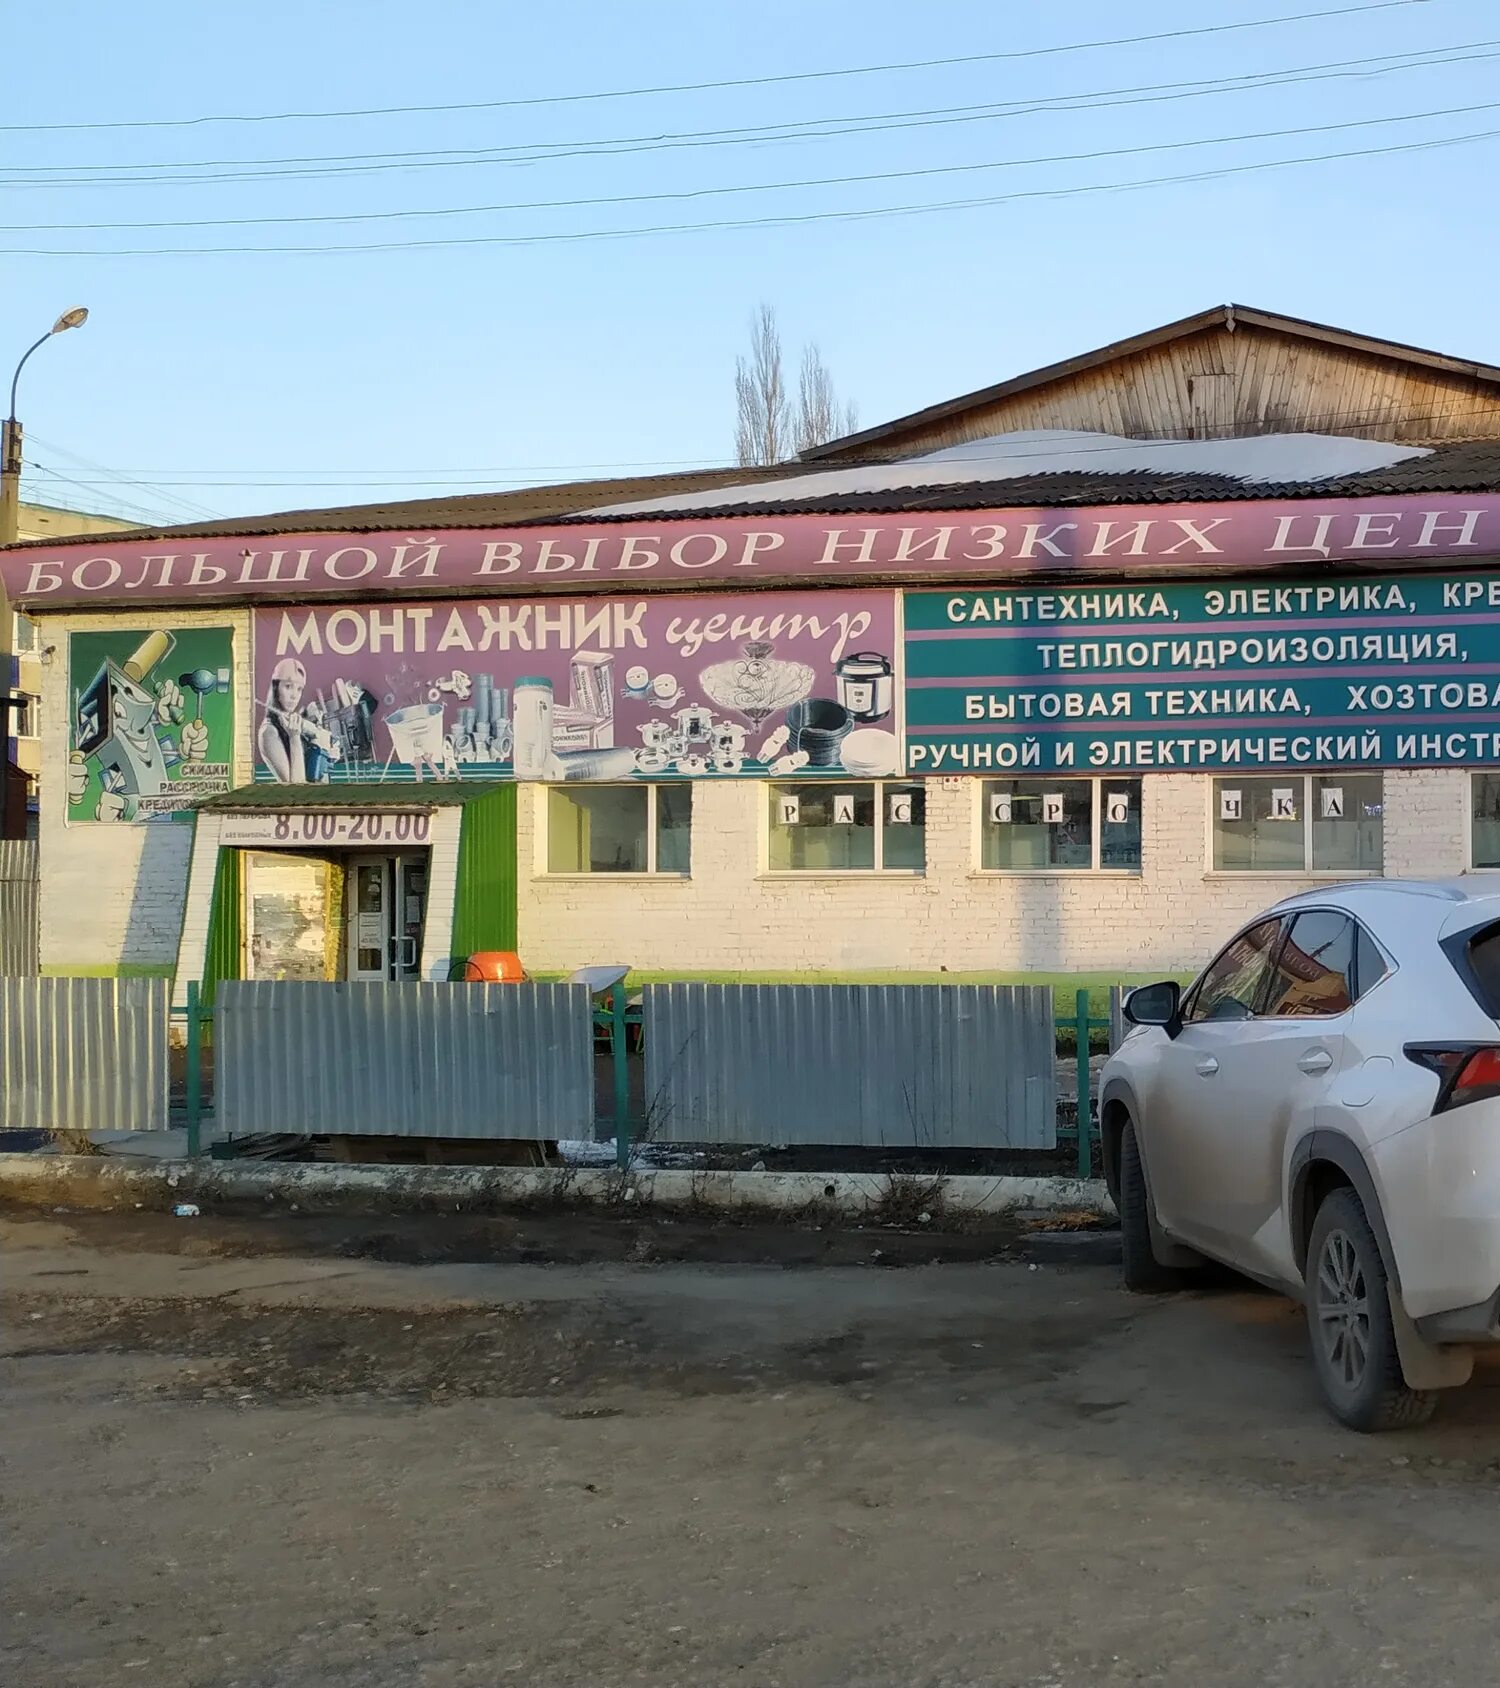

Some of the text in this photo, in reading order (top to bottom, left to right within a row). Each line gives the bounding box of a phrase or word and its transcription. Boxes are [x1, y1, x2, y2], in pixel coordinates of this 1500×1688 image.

[19, 536, 448, 595] БОЛЬШОЙ
[472, 531, 785, 576] ВЫБОР
[812, 517, 1232, 565] НИЗКИХ
[1264, 509, 1489, 558] ЦЕН
[946, 592, 1180, 622] САНТЕХНИКА,
[1204, 584, 1417, 616] ЭЛЕКТРИКА,
[275, 602, 872, 664] МОНТАЖНИК центр
[1037, 632, 1468, 670] ТЕПЛОГИДРОИЗОЛЯЦИЯ,
[965, 691, 1132, 720] БЫТОВАЯ
[1145, 686, 1311, 716] ТЕХНИКА,
[908, 736, 1041, 769] РУЧНОЙ
[1055, 741, 1075, 766] И
[1088, 729, 1382, 766] ЭЛЕКТРИЧЕСКИЙ
[159, 781, 229, 794] РАССРОЧКА
[181, 764, 229, 777] СКИДКИ
[274, 814, 430, 840] 8.00-20.00
